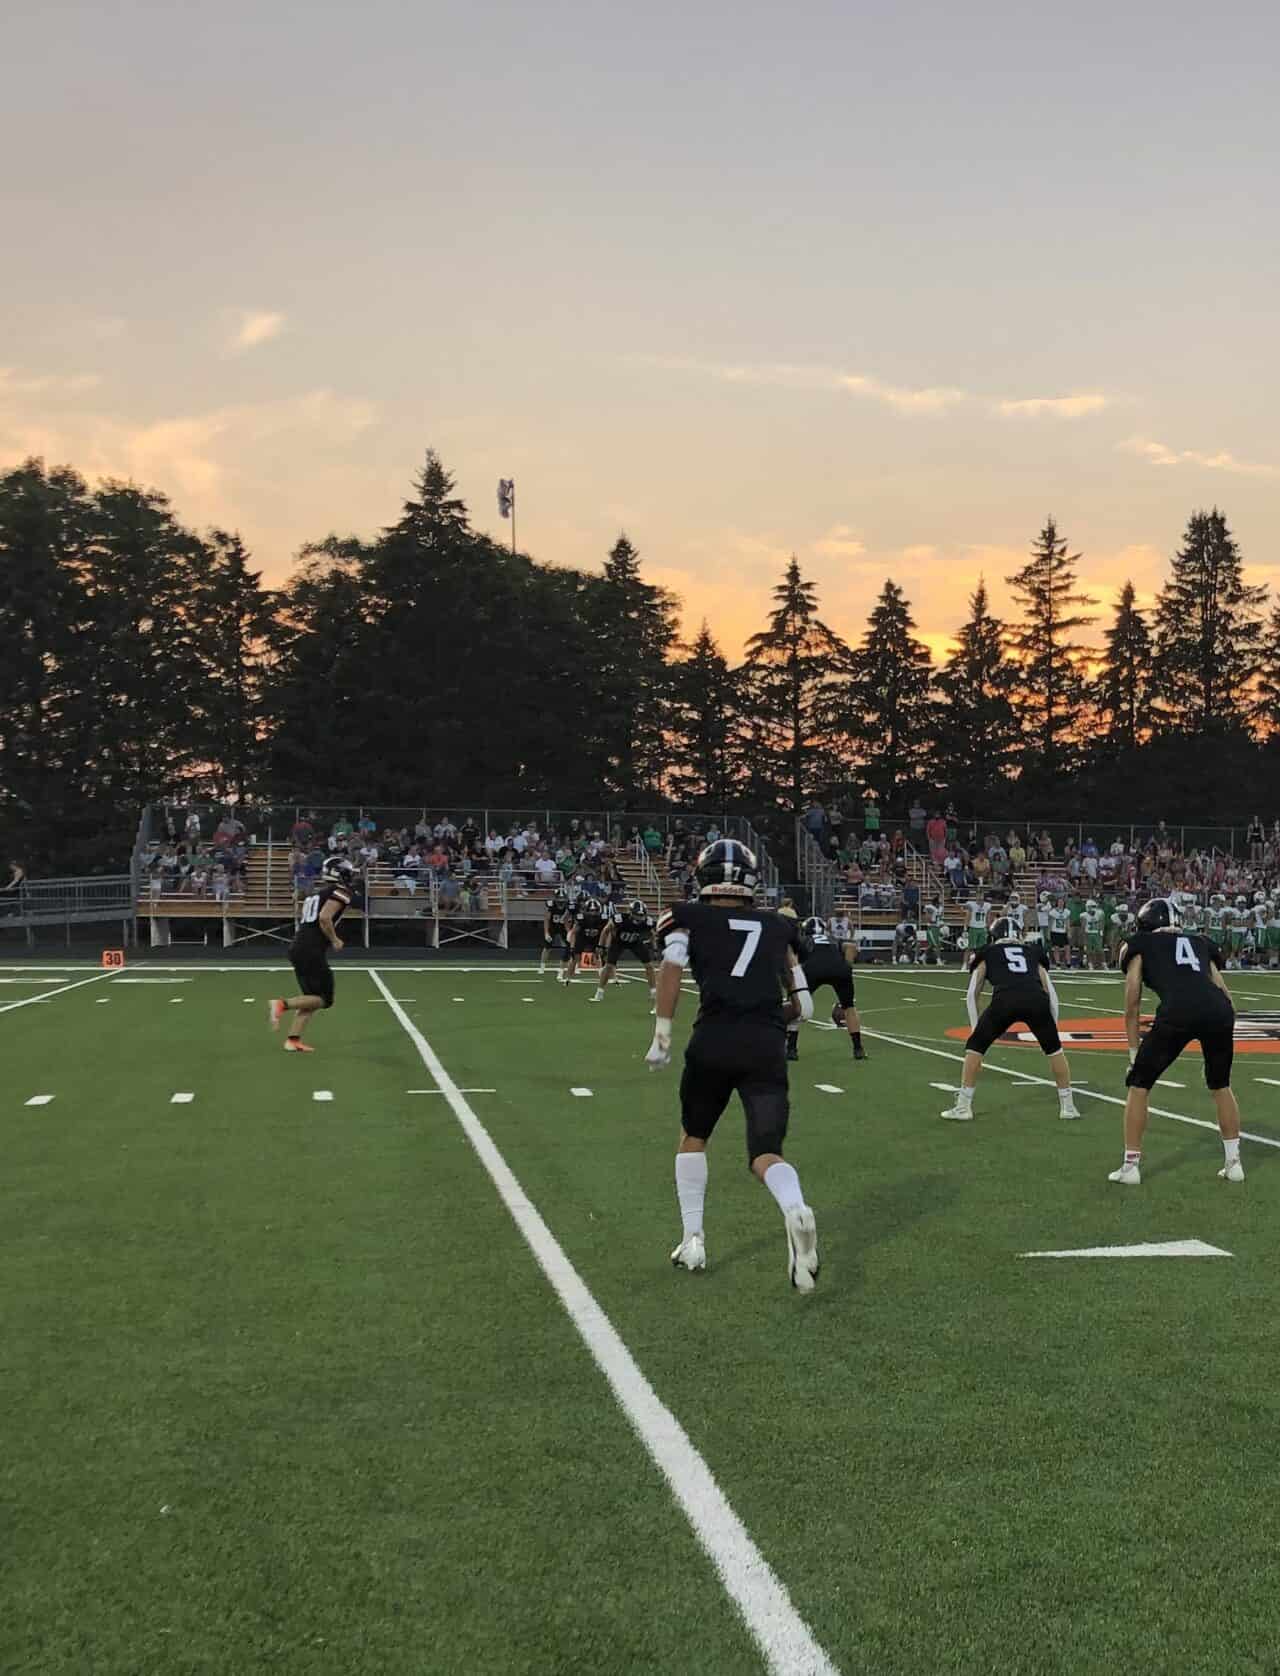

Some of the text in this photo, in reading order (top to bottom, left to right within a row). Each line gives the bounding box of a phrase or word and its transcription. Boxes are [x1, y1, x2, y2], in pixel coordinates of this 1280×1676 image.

[105, 952, 121, 966] 30
[728, 919, 762, 976] 7
[1004, 947, 1028, 973] 5
[1175, 937, 1200, 972] 4
